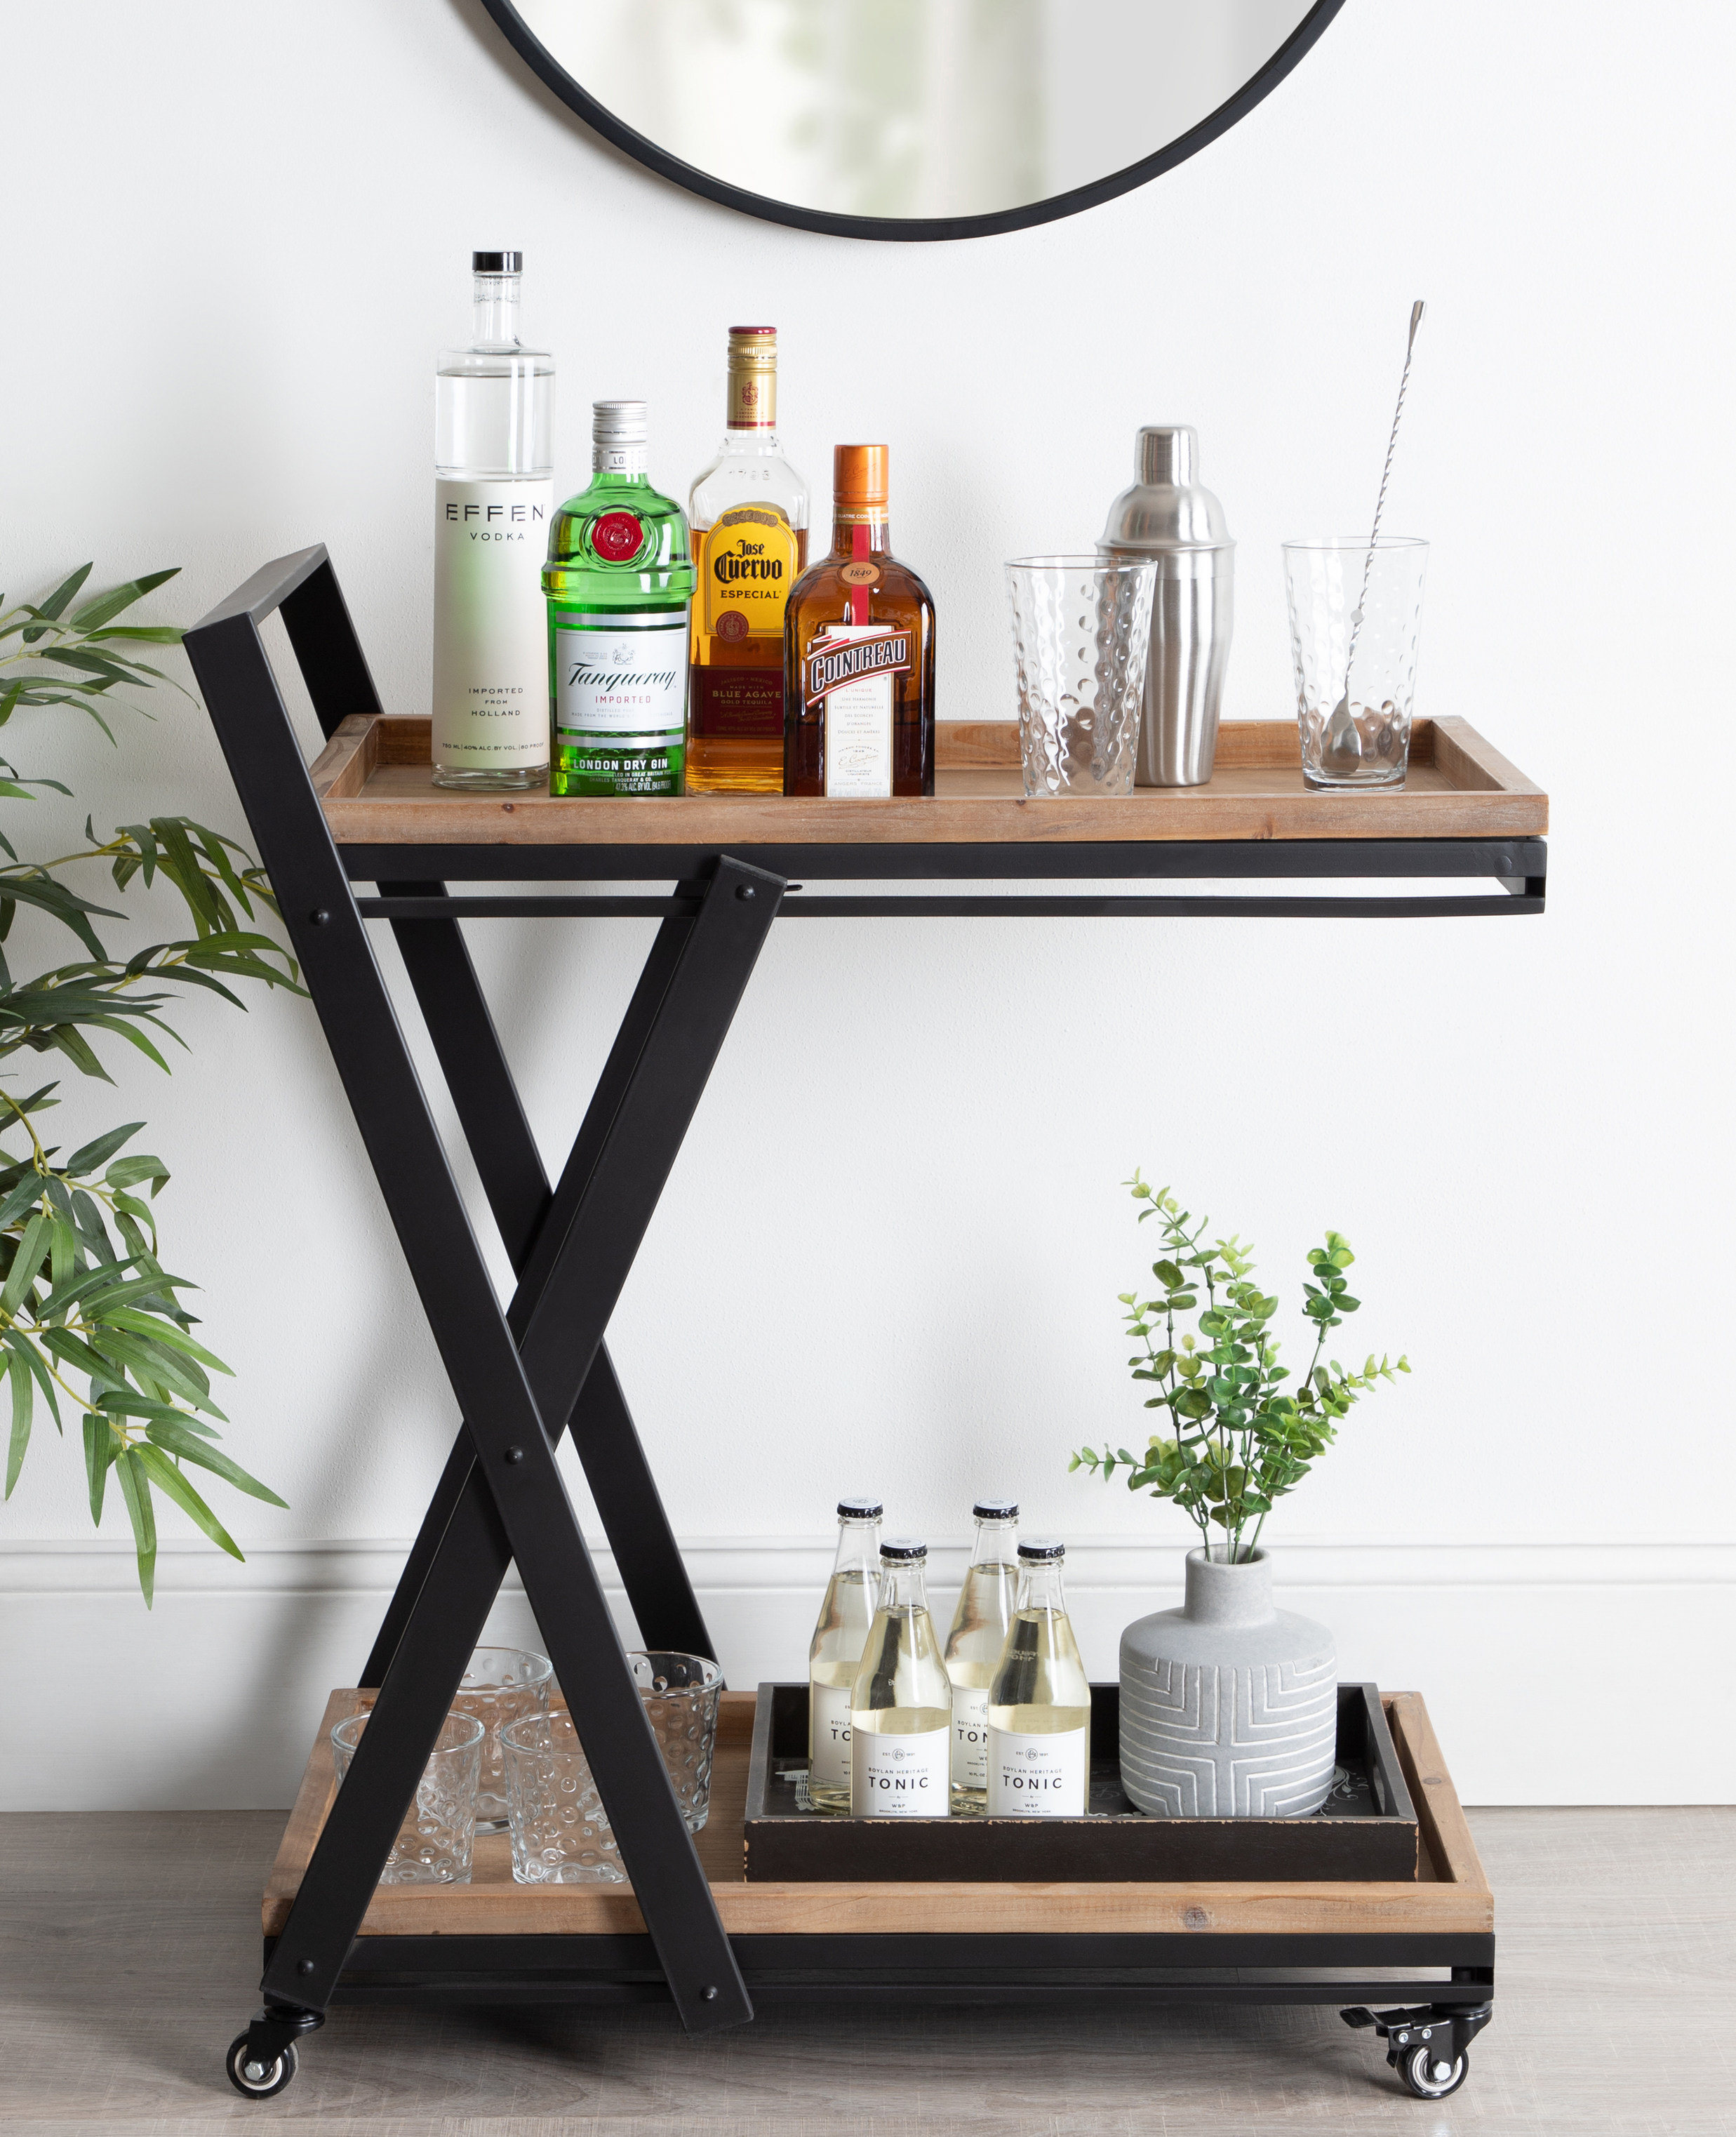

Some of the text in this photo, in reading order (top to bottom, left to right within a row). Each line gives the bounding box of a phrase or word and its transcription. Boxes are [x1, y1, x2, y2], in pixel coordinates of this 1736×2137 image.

[446, 503, 544, 522] EFFEN
[470, 532, 525, 541] VODKA
[737, 539, 765, 559] Jose
[714, 550, 782, 585] Cuervo
[720, 590, 780, 599] ESPECIAL
[810, 638, 907, 694] COINTREAU
[568, 662, 676, 693] Tanqueray
[595, 695, 651, 704] IMPORTED
[573, 758, 667, 771] LONDON DRY GIN
[958, 1729, 988, 1743] TON
[1003, 1766, 1027, 1774] BOYLAN
[868, 1776, 928, 1790] TONIC
[1003, 1774, 1062, 1790] TONIC
